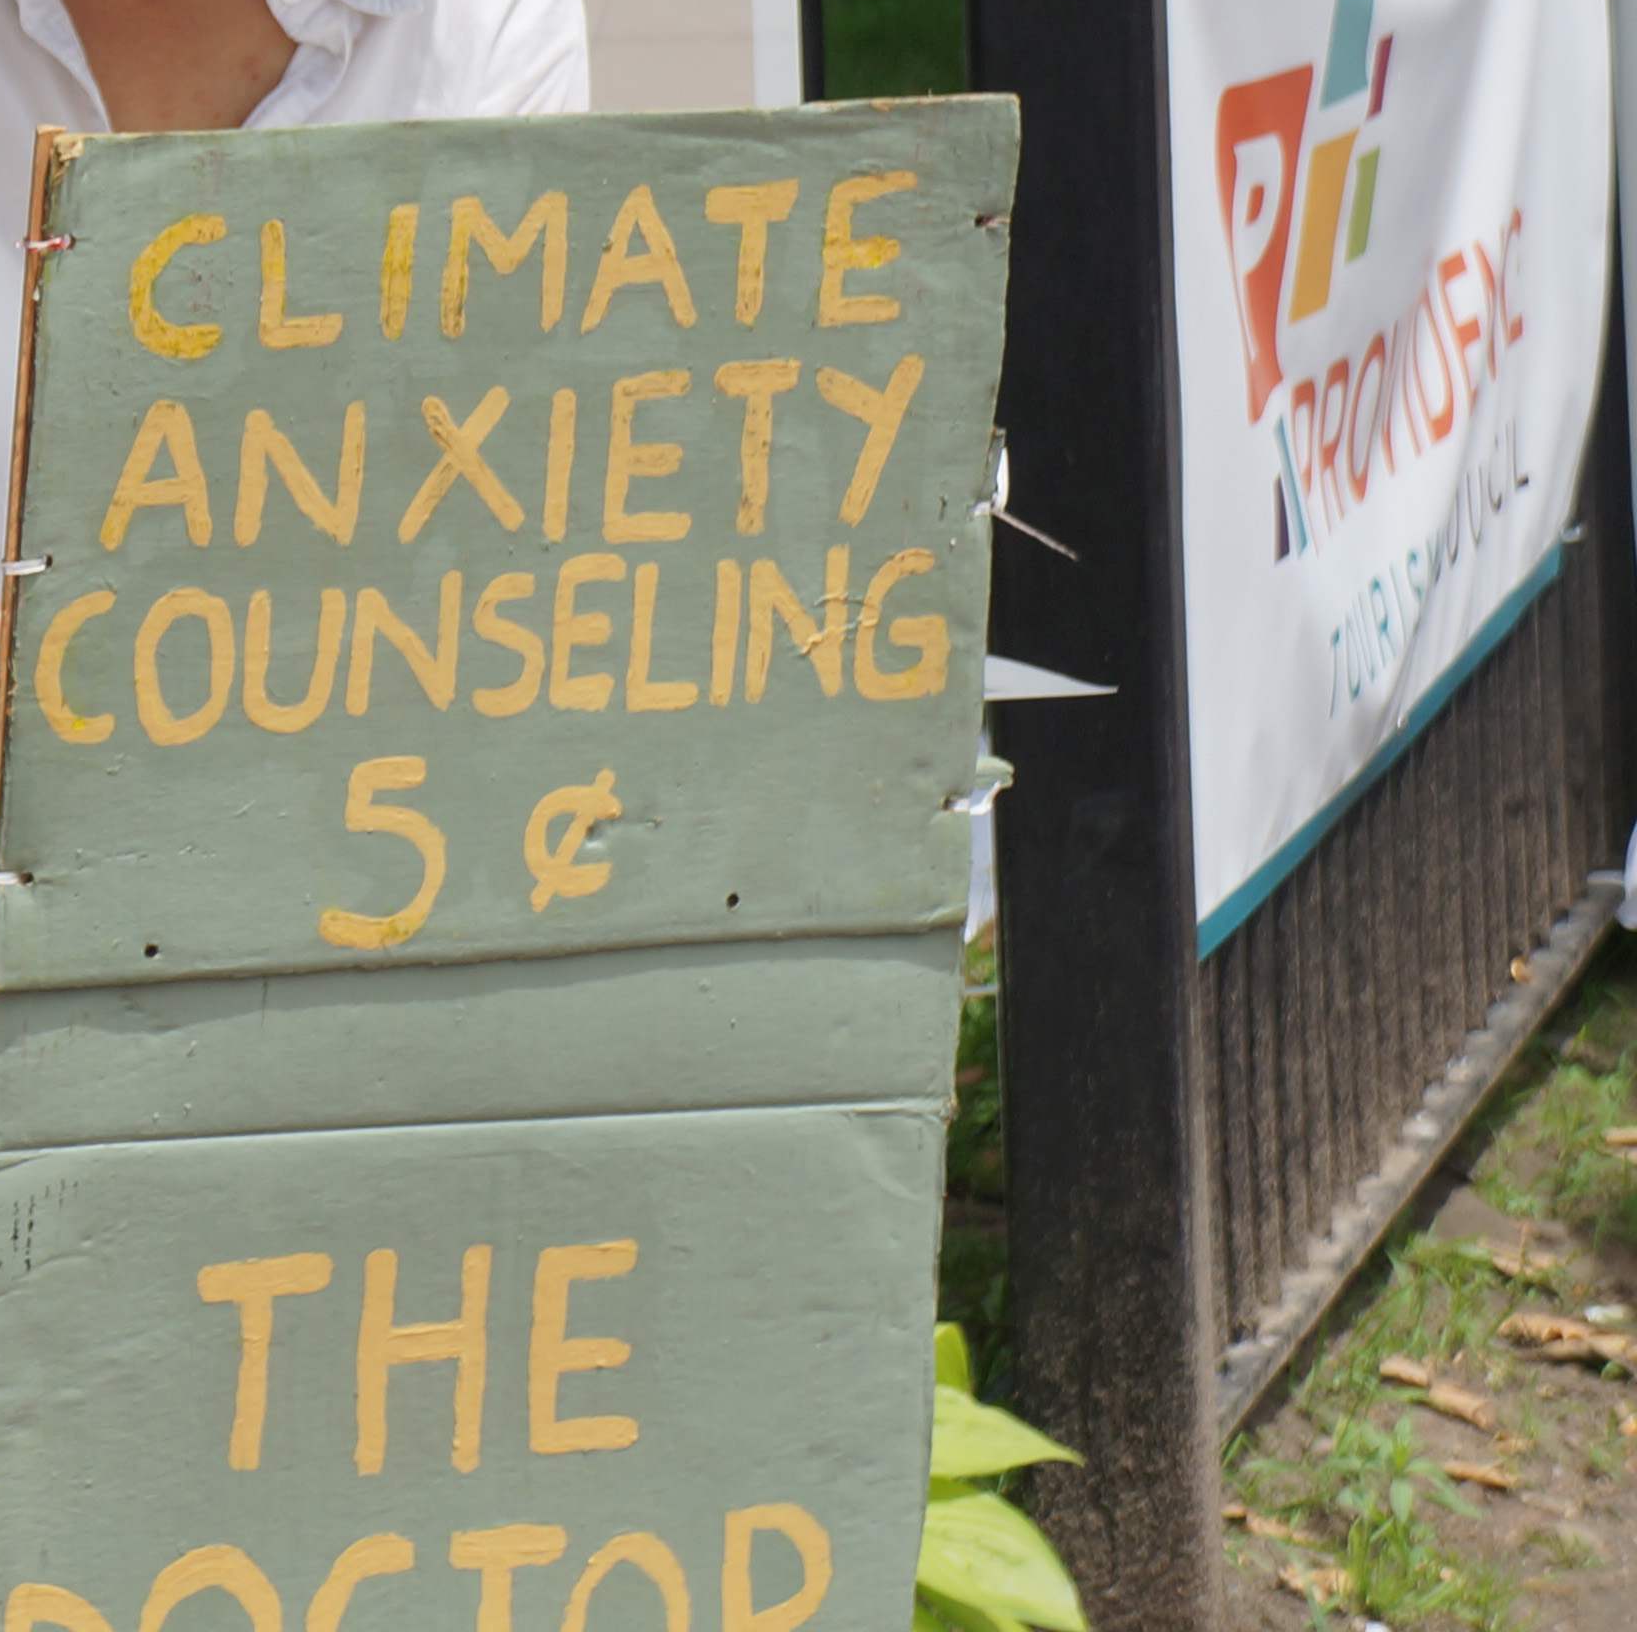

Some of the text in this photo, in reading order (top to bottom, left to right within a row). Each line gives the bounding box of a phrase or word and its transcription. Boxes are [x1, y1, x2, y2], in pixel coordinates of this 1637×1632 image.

[129, 171, 919, 361] CLIMATE
[99, 354, 924, 552] ANXIETY
[35, 544, 948, 746] COUNSELING
[320, 755, 446, 949] 5
[197, 1237, 640, 1476] THE
